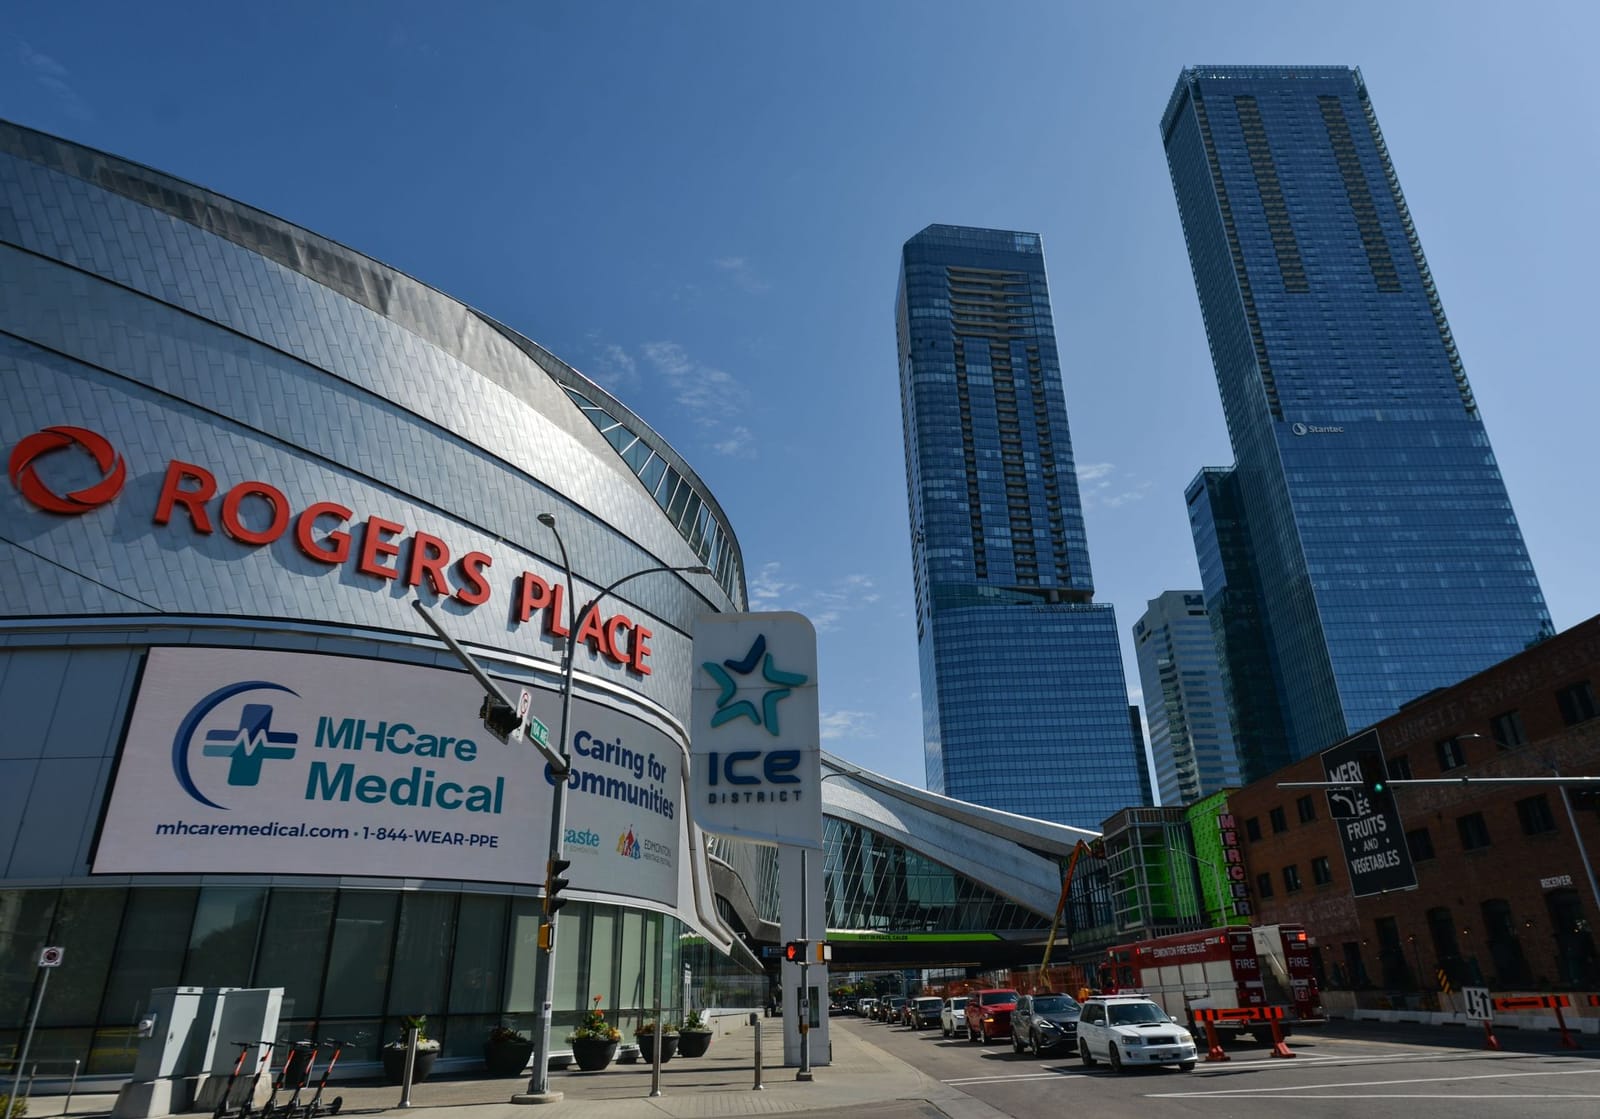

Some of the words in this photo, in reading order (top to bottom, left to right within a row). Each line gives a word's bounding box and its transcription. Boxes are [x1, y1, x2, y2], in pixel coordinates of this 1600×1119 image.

[1308, 425, 1344, 433] Stantec
[154, 459, 492, 605] ROGERS
[519, 571, 653, 676] PLACE
[314, 716, 478, 762] MHCare
[573, 730, 645, 779] Caring
[647, 752, 667, 783] for
[305, 761, 505, 814] Medical
[708, 790, 802, 804] DISTRICT
[155, 820, 349, 839] mhcaremedical.com
[362, 826, 499, 848] 1-844-WEAR-PPE
[1346, 813, 1387, 840] FRUITS
[1363, 838, 1379, 851] AND
[1220, 814, 1251, 915] MERCER
[1351, 850, 1400, 874] VEGETABLES
[1153, 947, 1176, 958] EDMONTON
[1176, 943, 1187, 955] FIRE
[1187, 942, 1206, 953] RESCUE
[1288, 956, 1310, 968] FIRE
[1235, 958, 1256, 969] FIRE
